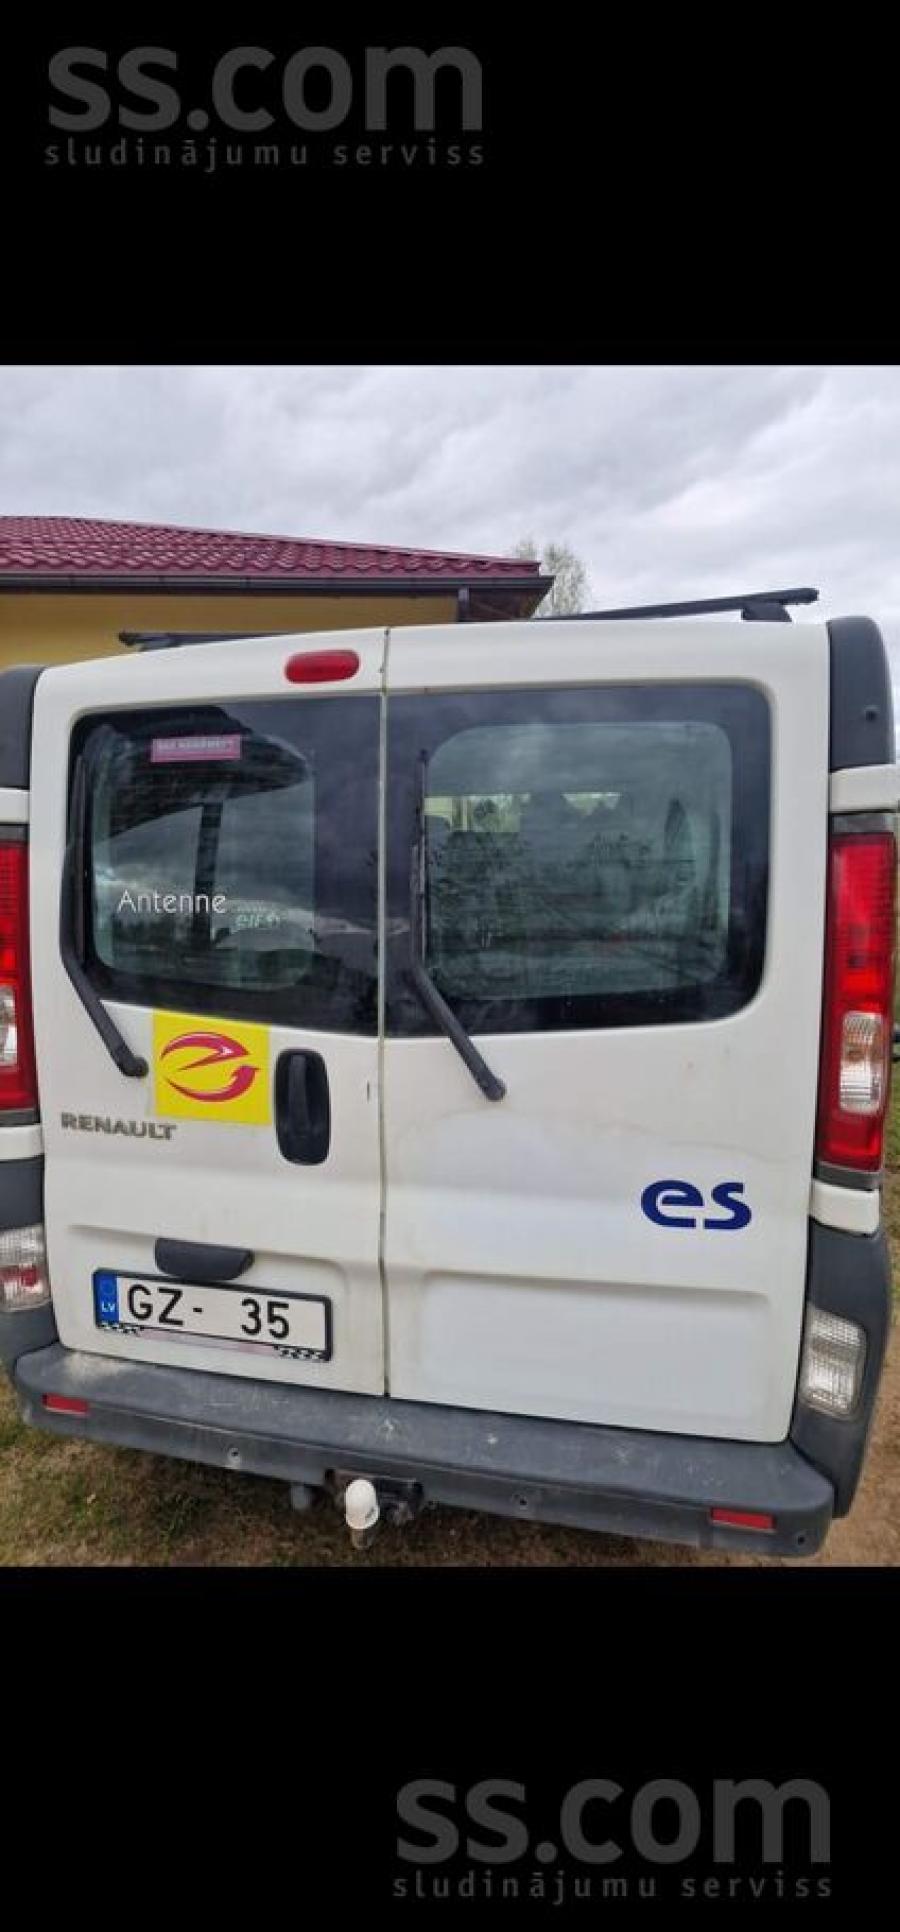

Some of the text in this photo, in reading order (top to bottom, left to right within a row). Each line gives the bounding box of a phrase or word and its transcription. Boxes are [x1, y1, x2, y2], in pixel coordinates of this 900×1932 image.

[117, 889, 227, 914] Antenne
[61, 1112, 177, 1140] RENAULT
[641, 1179, 752, 1230] es
[101, 1302, 116, 1313] LV
[240, 1297, 290, 1339] 35
